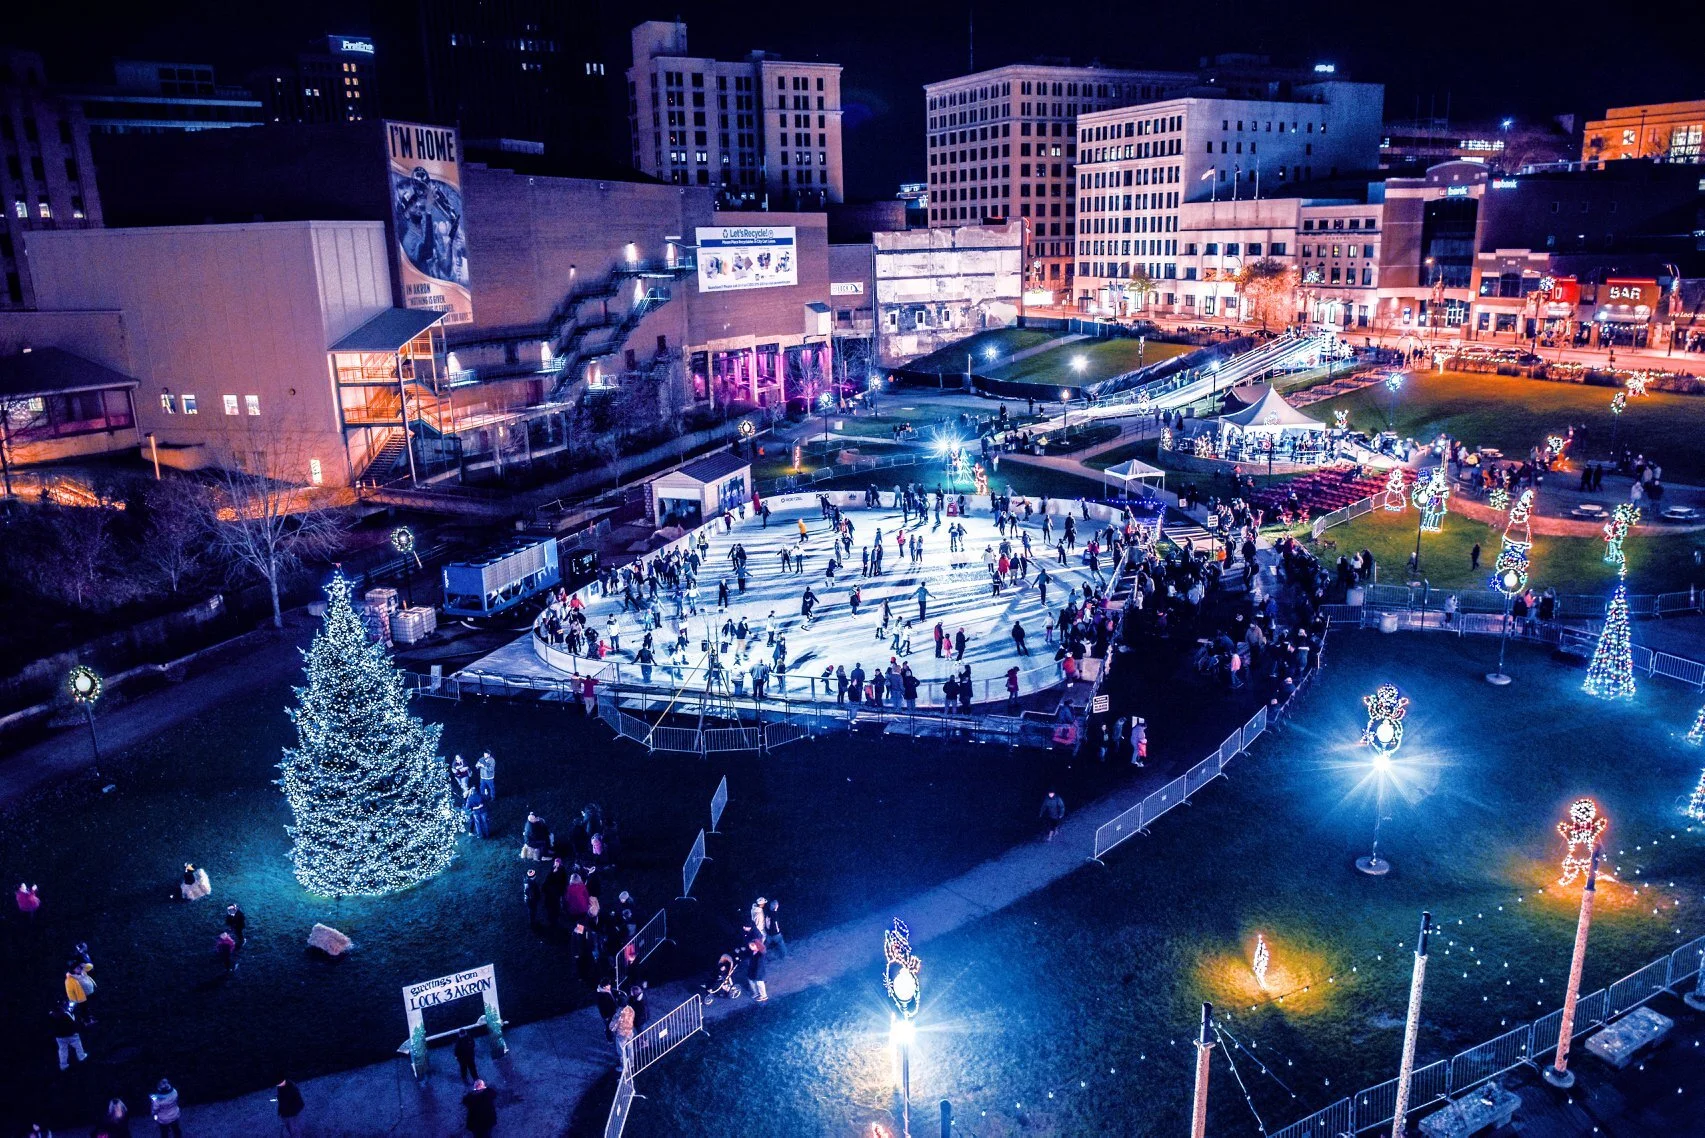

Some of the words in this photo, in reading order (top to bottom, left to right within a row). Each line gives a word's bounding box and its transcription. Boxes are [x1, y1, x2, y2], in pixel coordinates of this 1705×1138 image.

[389, 125, 413, 159] I'M
[415, 128, 455, 162] HOME
[1448, 186, 1467, 196] bank
[730, 229, 744, 238] Let's
[744, 228, 768, 239] Recycle!
[406, 284, 412, 295] IN
[413, 283, 431, 295] AKRON
[1610, 286, 1641, 299] BAR
[410, 976, 452, 997] greetings
[455, 971, 478, 984] from
[410, 991, 441, 1011] LOCK
[444, 988, 453, 1001] 3
[454, 977, 492, 998] AKRON
